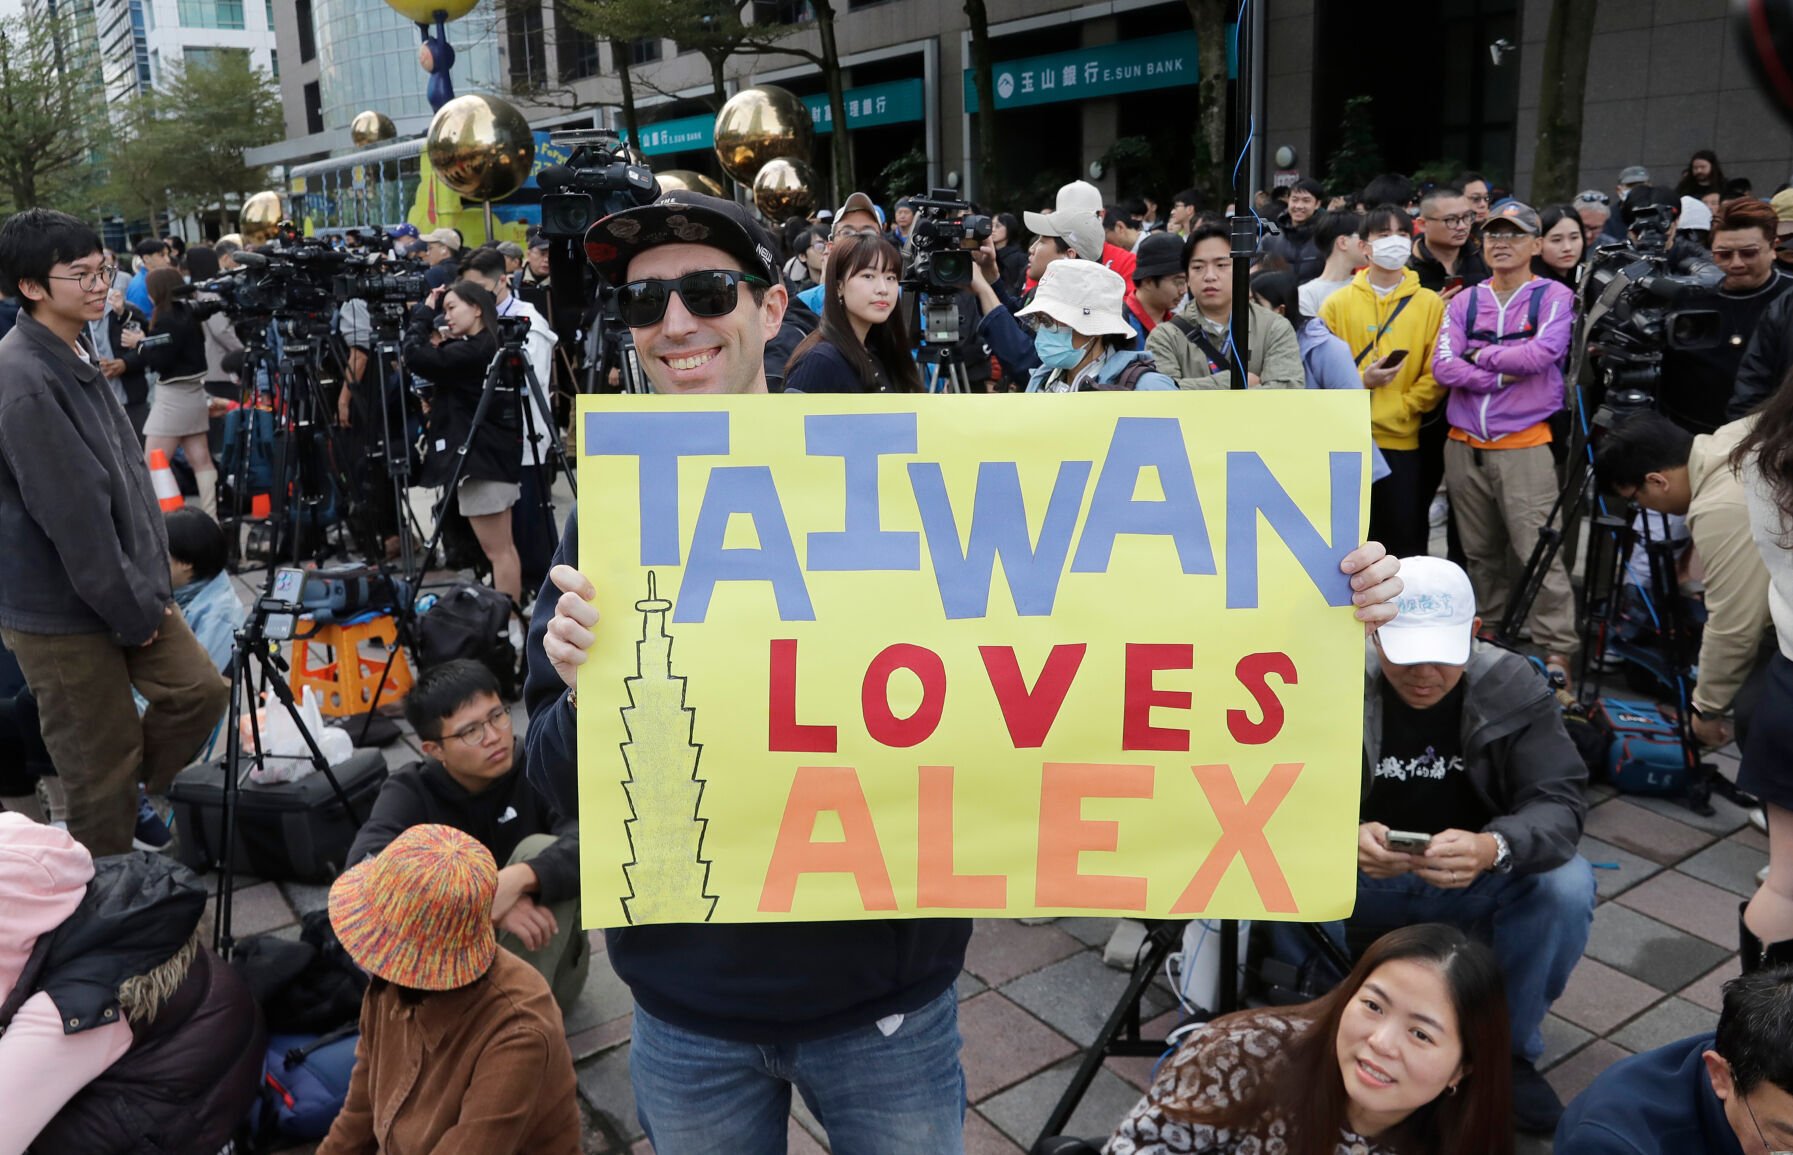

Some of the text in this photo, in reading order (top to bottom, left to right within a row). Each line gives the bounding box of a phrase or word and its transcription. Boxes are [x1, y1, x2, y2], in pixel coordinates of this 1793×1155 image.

[1021, 61, 1099, 93] 玉山銀行
[1104, 58, 1184, 82] E.SUN BANK
[811, 96, 886, 122] 財富理銀行
[638, 130, 668, 147] 山銀行
[755, 242, 773, 263] NEW
[584, 411, 1363, 624] TAIWAN
[769, 638, 1299, 752] LOVES
[757, 762, 1305, 914] ALEX
